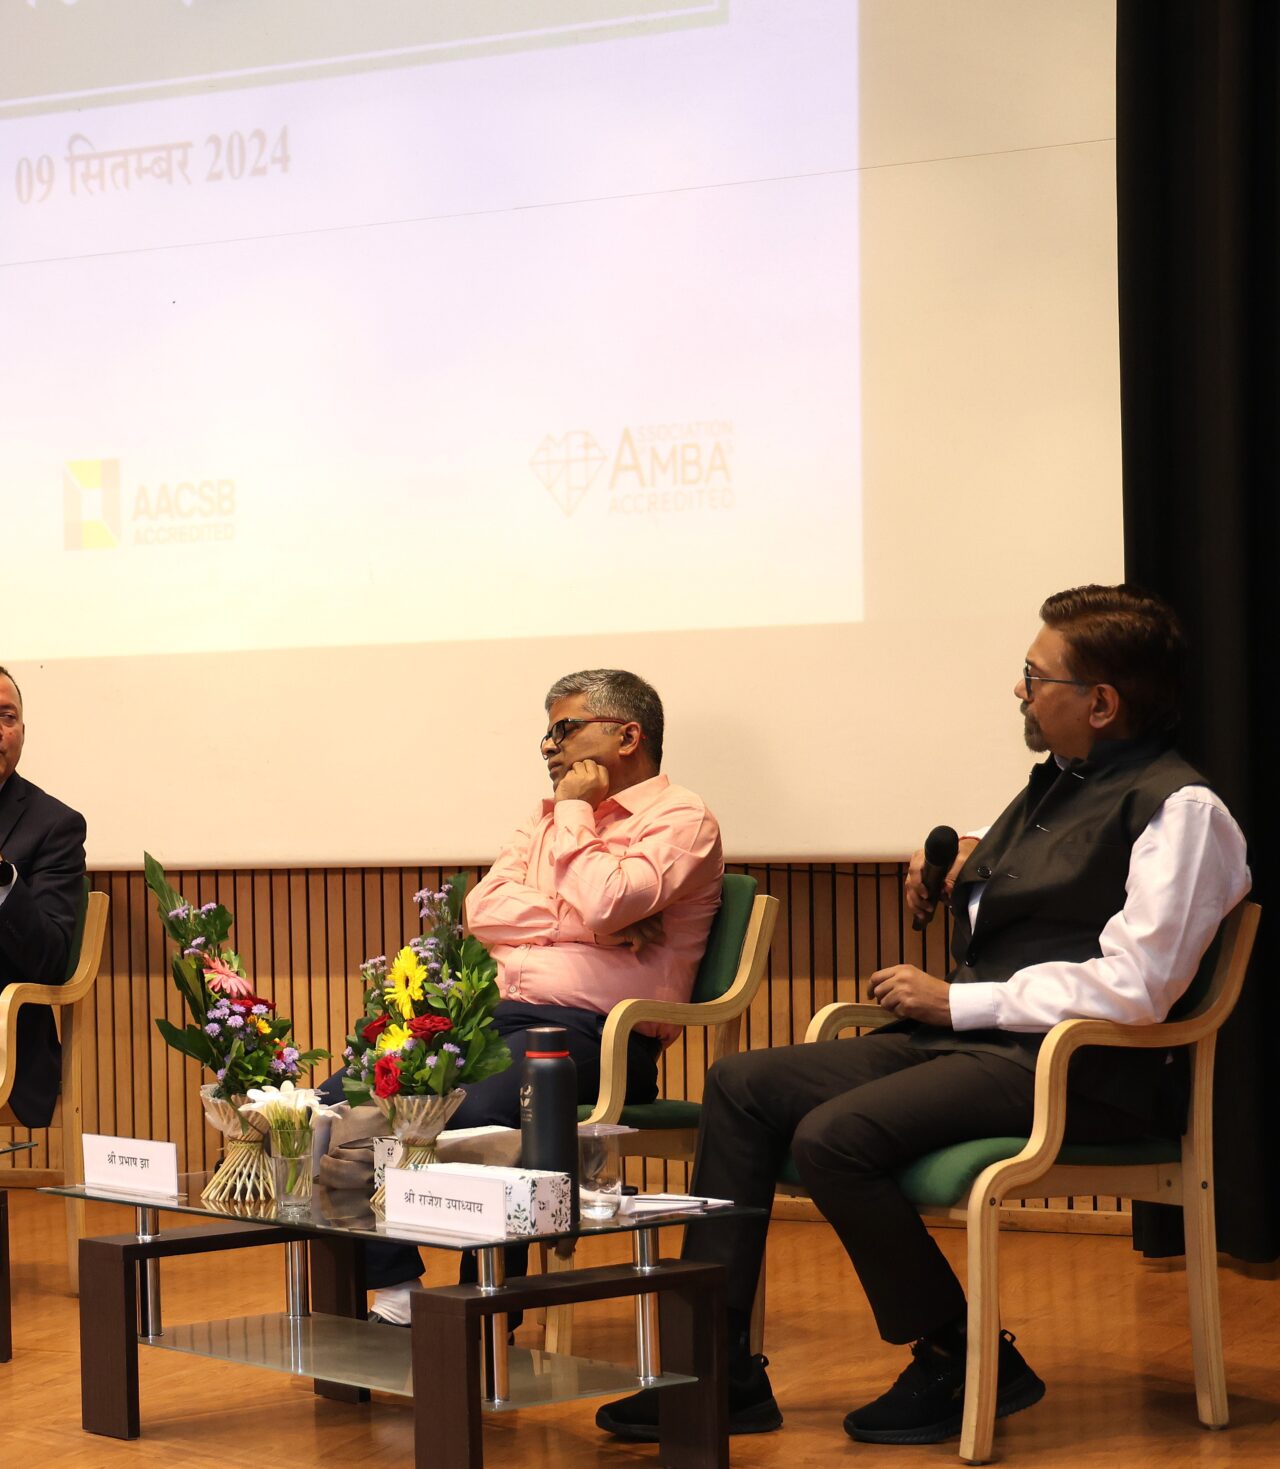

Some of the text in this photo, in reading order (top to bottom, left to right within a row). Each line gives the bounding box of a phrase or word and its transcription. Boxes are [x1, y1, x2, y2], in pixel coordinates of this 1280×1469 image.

[15, 124, 292, 205] 09 सितम्बर 2024
[132, 479, 237, 521] AACSB
[609, 487, 734, 514] ACCREDITED
[133, 521, 237, 546] ACCREDITED
[107, 1151, 117, 1165] श्री
[139, 1157, 150, 1170] झा
[404, 1188, 484, 1215] श्री राजेश उपाध्याय
